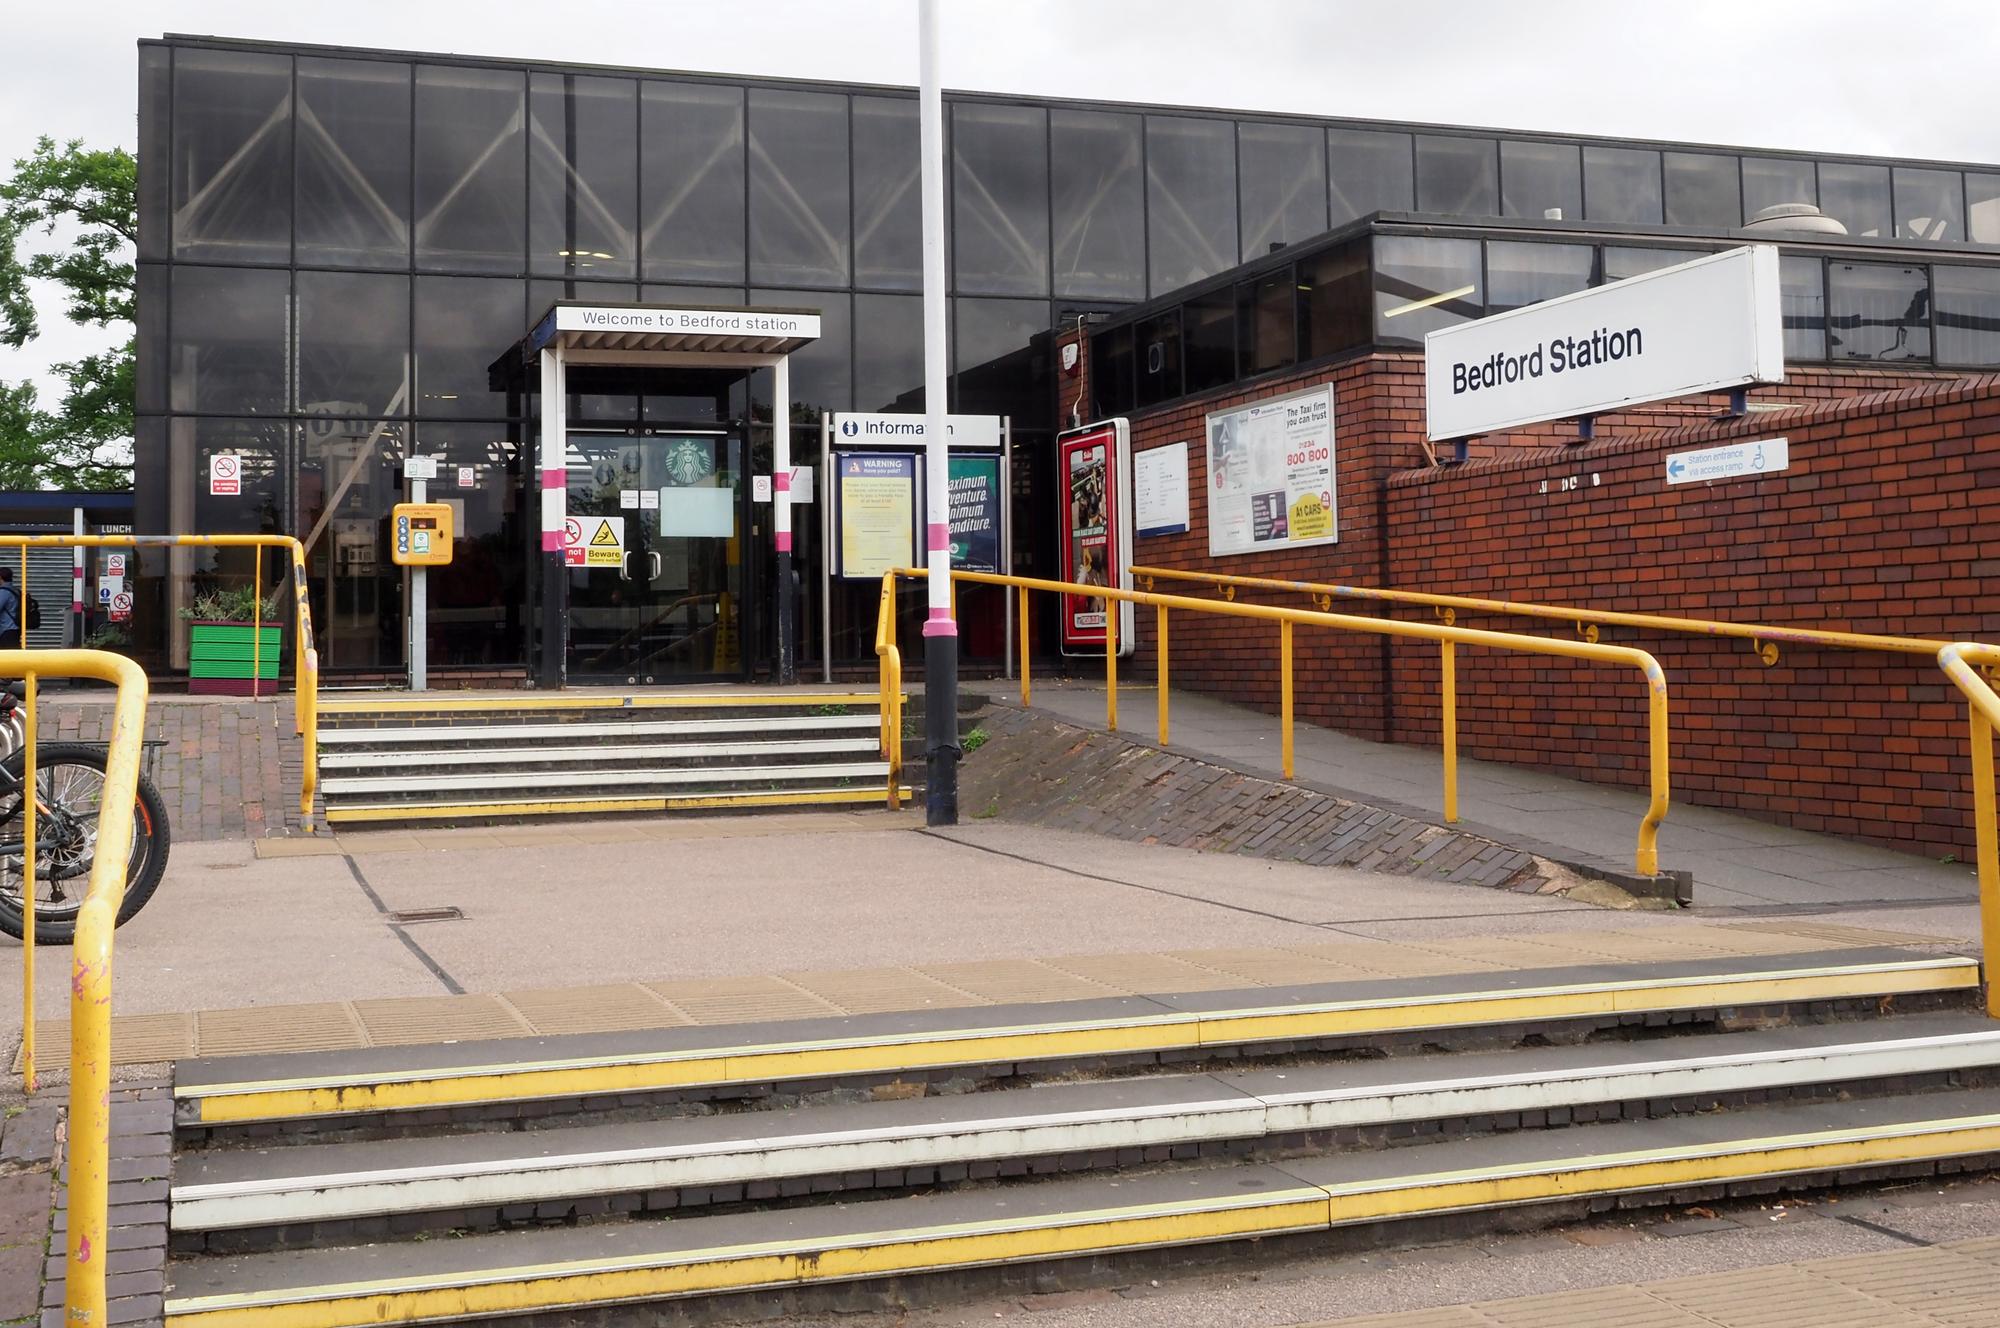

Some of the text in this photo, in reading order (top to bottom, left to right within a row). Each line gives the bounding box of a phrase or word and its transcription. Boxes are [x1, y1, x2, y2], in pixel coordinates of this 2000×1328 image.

[582, 311, 797, 331] Welcome to Bedford station
[1453, 327, 1642, 395] Bedford Station
[1287, 408, 1298, 417] The
[1300, 403, 1312, 415] Taxi
[1314, 402, 1326, 412] firm
[866, 421, 953, 434] Informan
[1286, 411, 1327, 429] you can trust
[863, 459, 902, 468] WARNING
[1287, 447, 1329, 466] 800 800
[1688, 449, 1744, 465] Station entrance
[1689, 462, 1743, 477] via access ramp
[948, 475, 987, 491] aximum
[948, 489, 988, 505] venture.
[949, 504, 984, 520] nimum
[1304, 503, 1321, 517] CARS
[101, 525, 132, 533] LUNCH
[948, 518, 991, 534] enditure.
[569, 548, 581, 556] not
[588, 550, 621, 558] Beware
